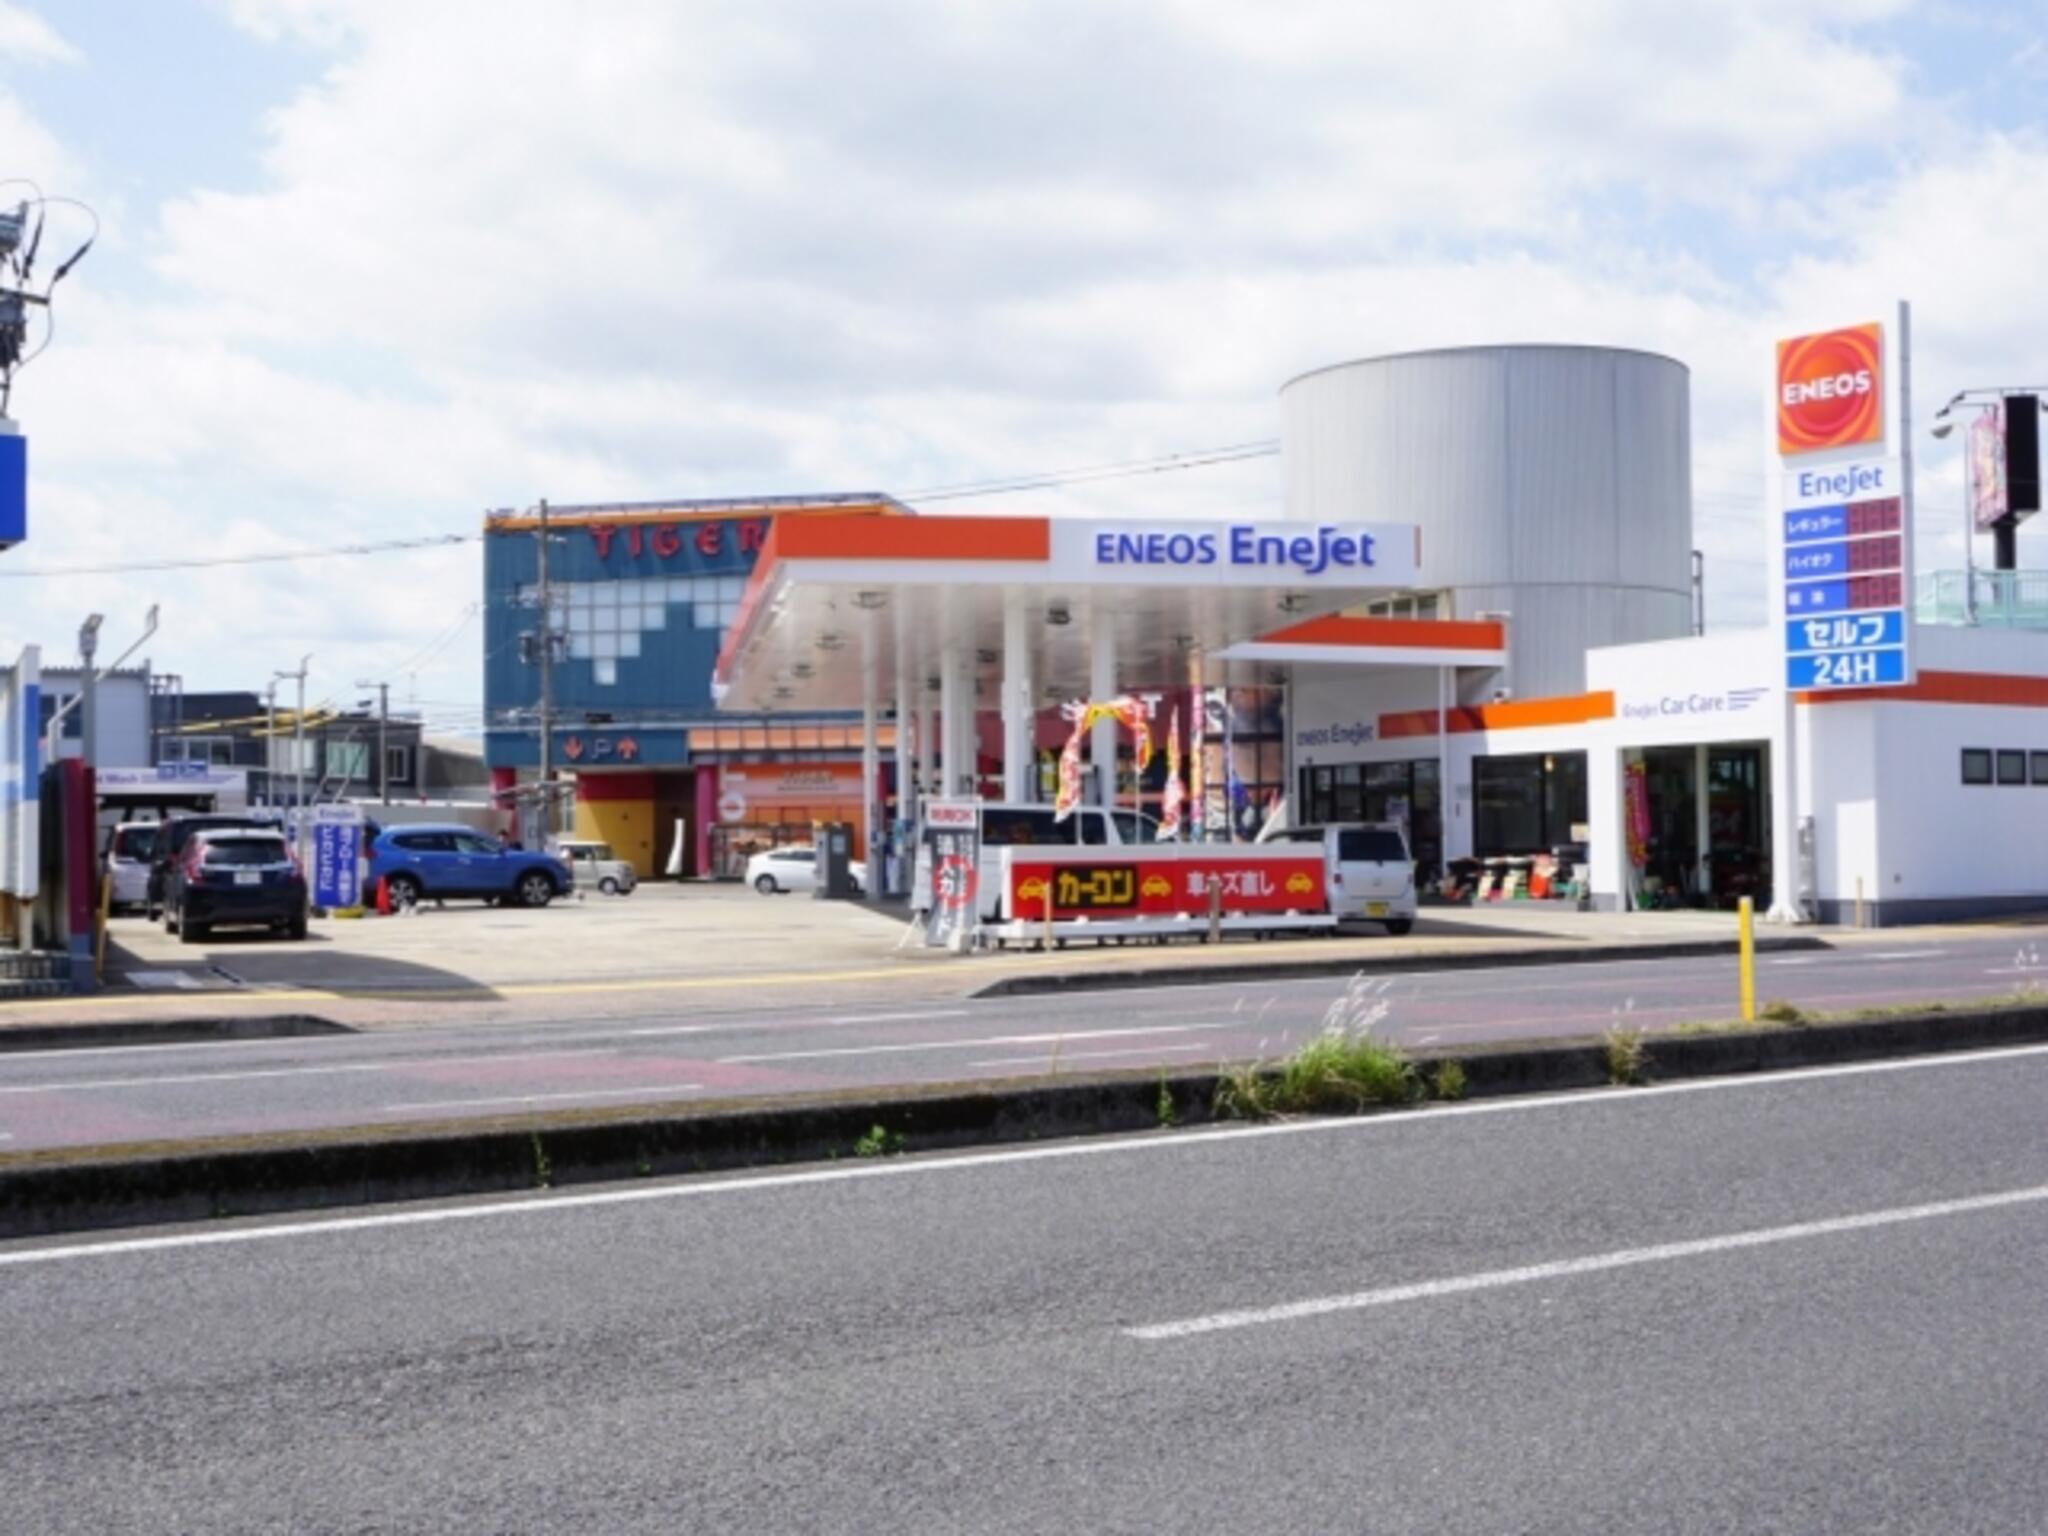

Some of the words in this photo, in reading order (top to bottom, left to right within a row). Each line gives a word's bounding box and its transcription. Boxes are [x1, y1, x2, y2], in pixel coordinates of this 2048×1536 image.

[1783, 369, 1872, 406] ENEOS
[1096, 533, 1216, 564] ENEOS
[1804, 616, 1885, 647] セルフ
[1813, 653, 1876, 684] 24H
[1058, 869, 1133, 904] カーコン
